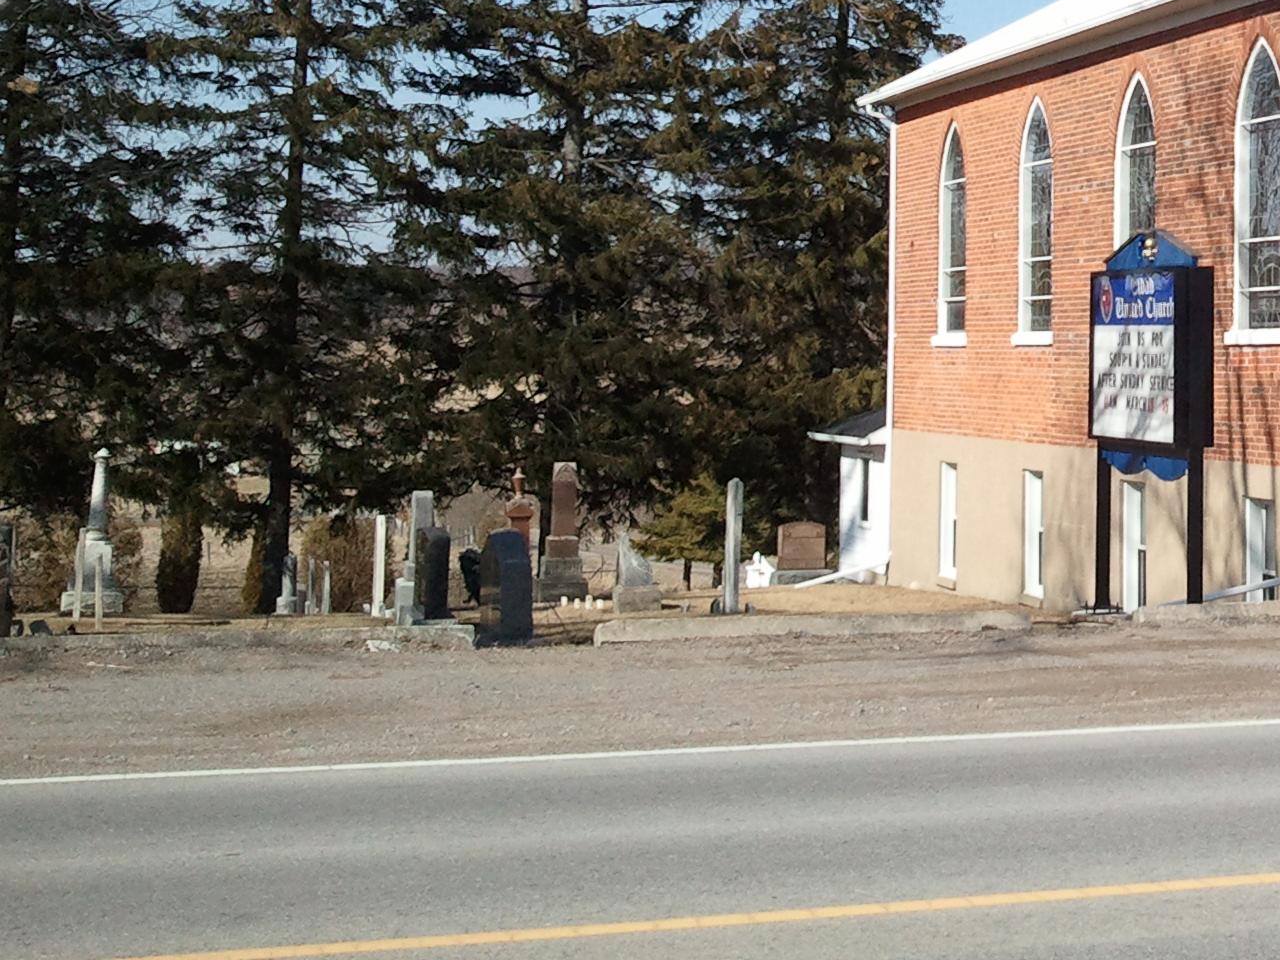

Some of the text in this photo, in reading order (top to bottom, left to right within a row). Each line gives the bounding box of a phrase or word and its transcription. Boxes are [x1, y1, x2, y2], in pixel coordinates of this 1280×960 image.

[1115, 296, 1174, 321] United Church
[1117, 331, 1163, 346] JOIN US FOR
[1097, 373, 1174, 391] AFTER SUNDAY SERVICE
